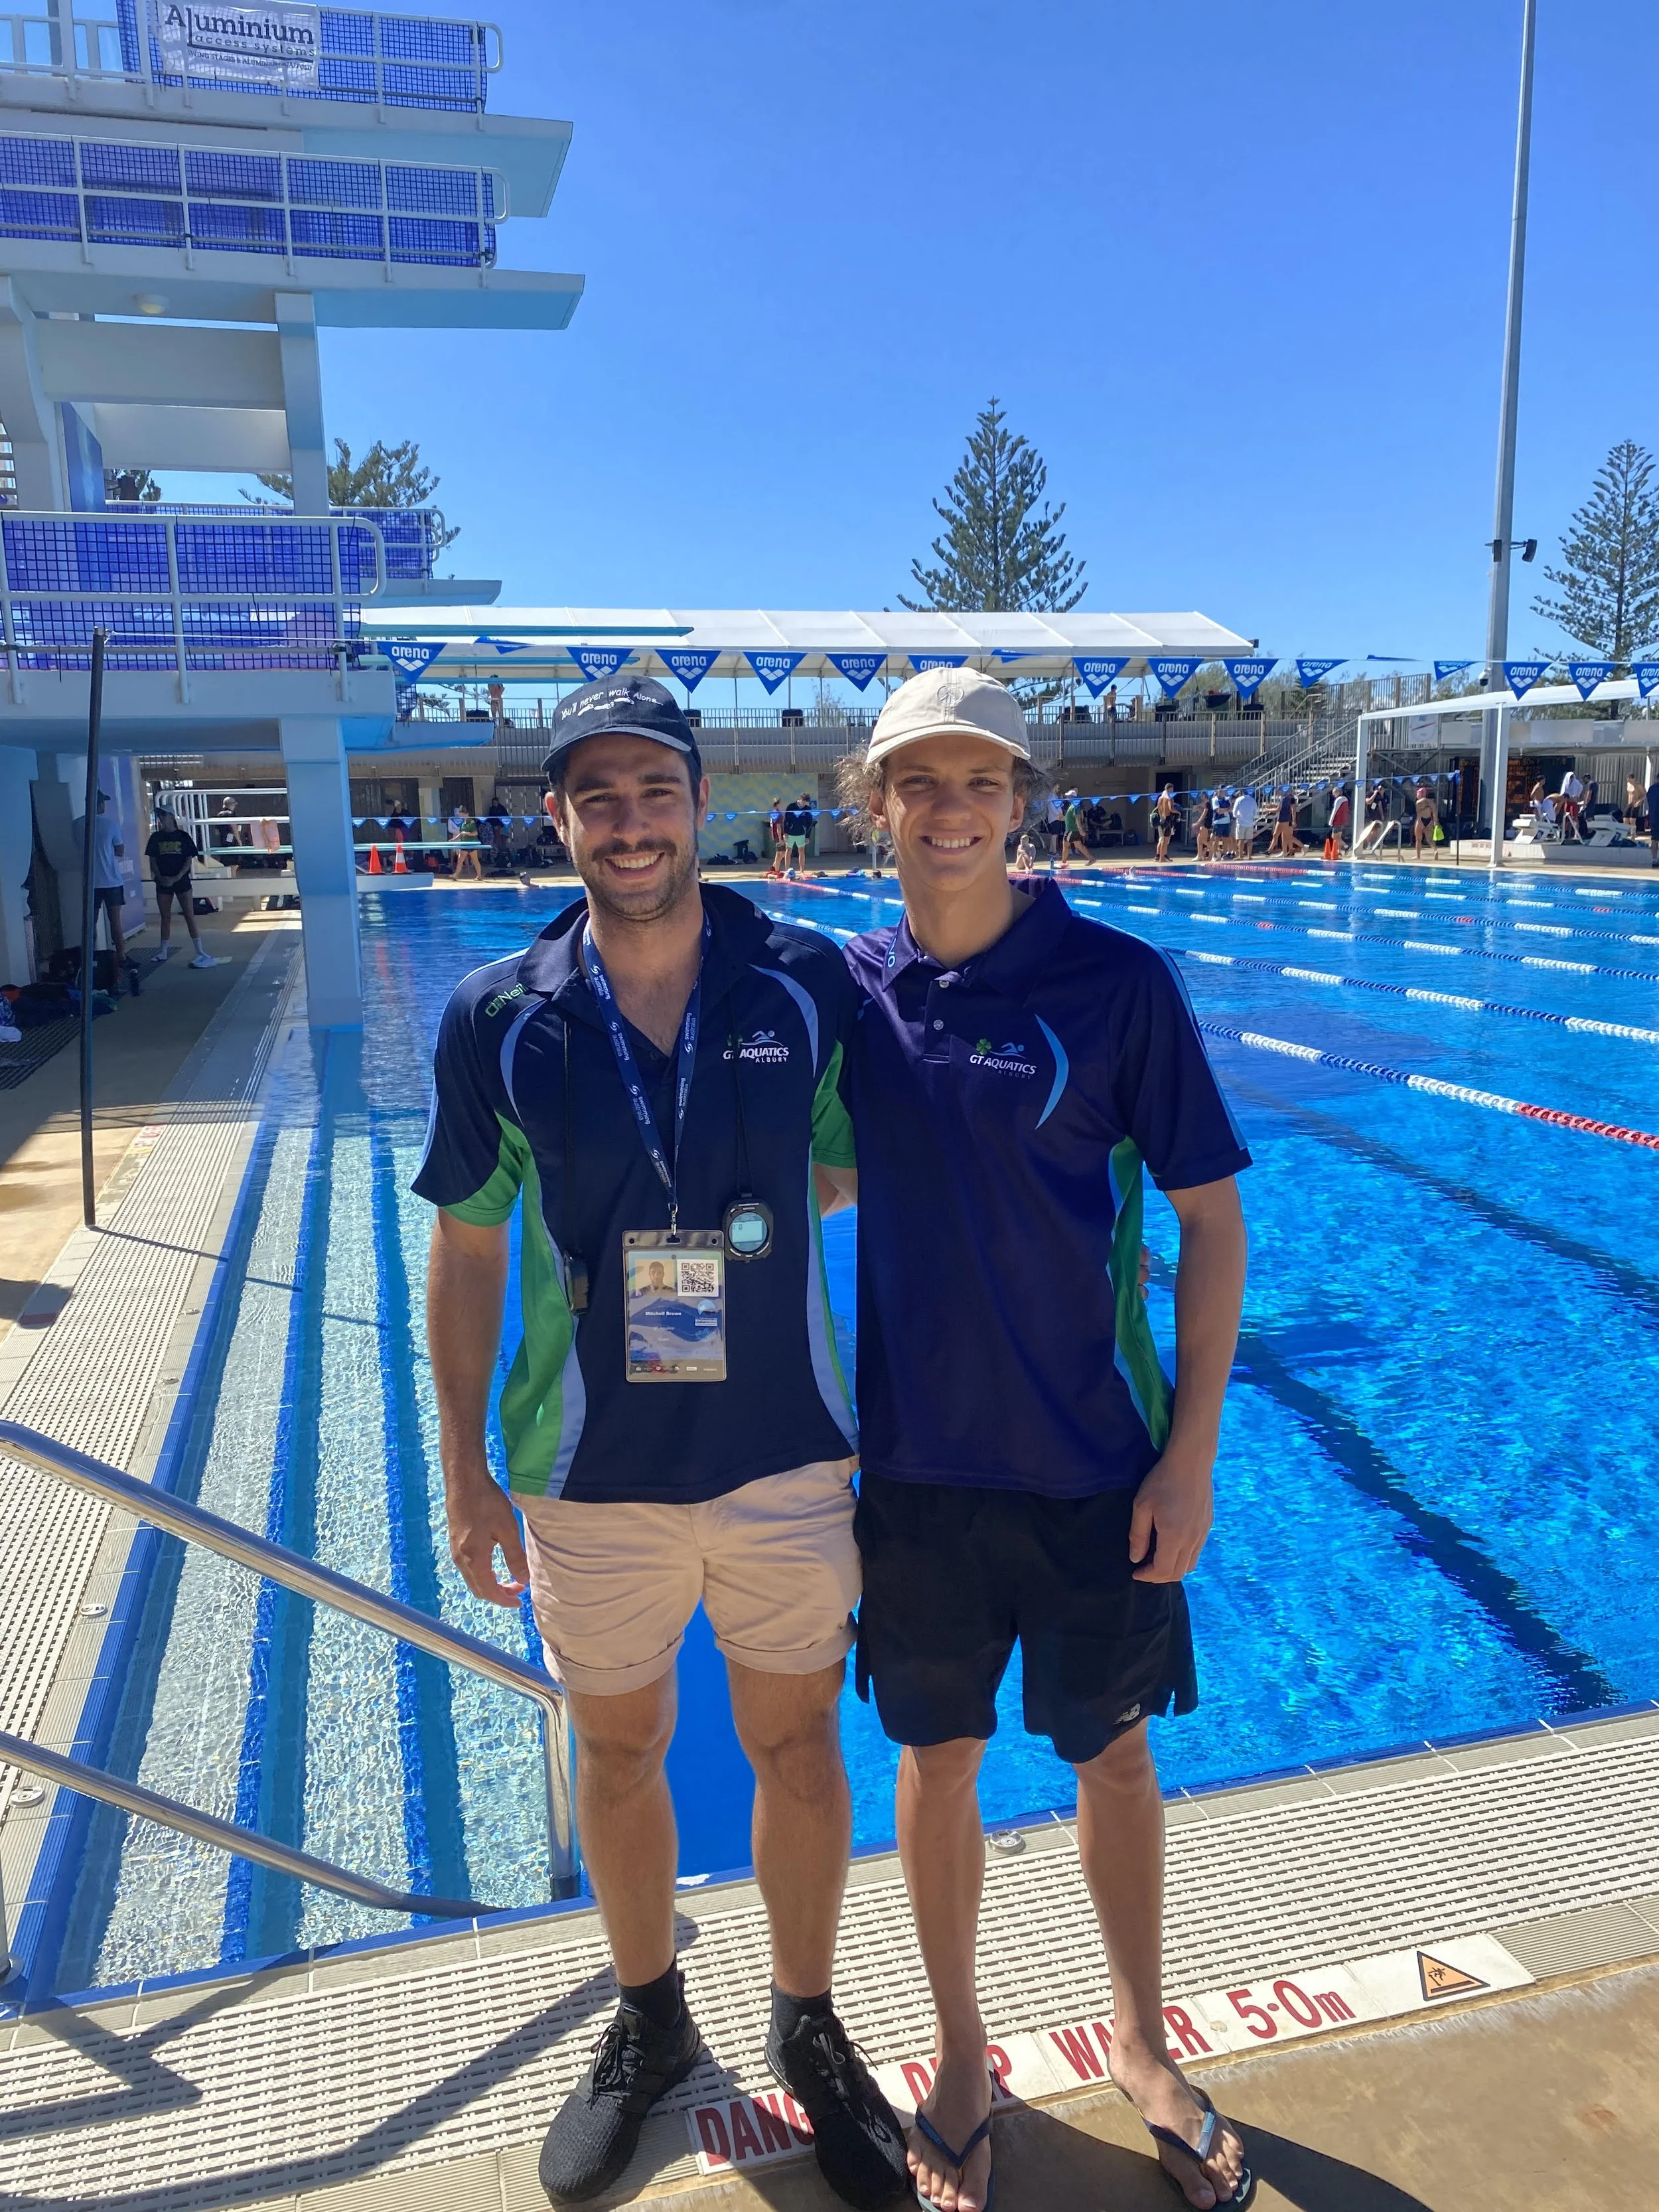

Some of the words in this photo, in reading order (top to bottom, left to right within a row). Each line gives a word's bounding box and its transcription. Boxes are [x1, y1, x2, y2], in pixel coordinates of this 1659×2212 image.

[165, 4, 315, 46] Aluminium
[194, 34, 248, 49] access
[254, 42, 315, 57] systems
[187, 50, 210, 59] SWING
[210, 53, 236, 63] STAGES
[392, 646, 430, 660] arena
[581, 652, 617, 665] arena
[671, 656, 707, 666] arena
[756, 656, 791, 668] arena
[841, 657, 876, 669] arena
[1083, 662, 1116, 674] arena
[1157, 662, 1189, 674] arena
[1234, 664, 1264, 674] arena
[1510, 666, 1538, 676] arena
[1575, 667, 1603, 677] arena
[1640, 668, 1659, 677] aren
[579, 692, 604, 709] never
[609, 688, 630, 697] walk
[617, 1032, 630, 1061] swimming
[739, 1047, 790, 1059] AQUATICS
[970, 1055, 985, 1065] GT
[983, 1057, 1037, 1074] AQUATICS
[638, 1096, 651, 1125] swimming
[695, 2092, 815, 2167] DANG
[900, 2045, 1013, 2106] DP
